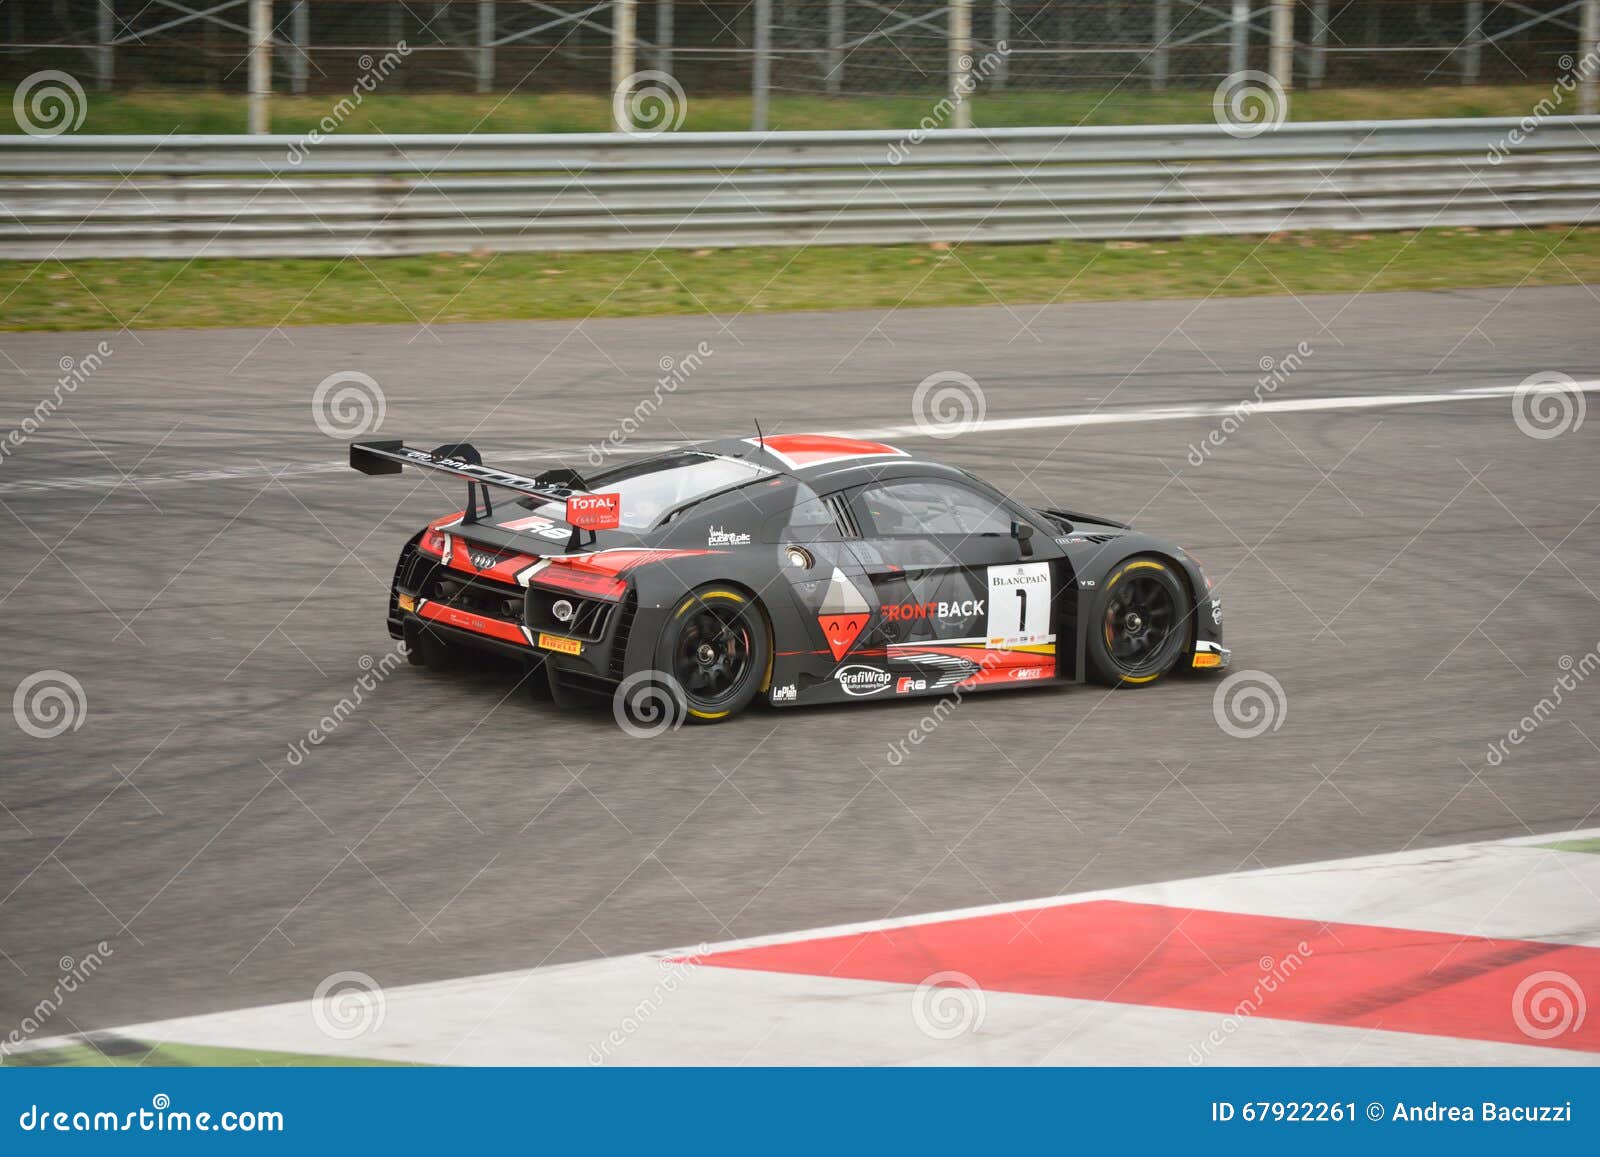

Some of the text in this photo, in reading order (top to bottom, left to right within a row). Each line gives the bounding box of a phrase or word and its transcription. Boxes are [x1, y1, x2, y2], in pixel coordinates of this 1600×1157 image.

[570, 497, 615, 510] TOTAL
[993, 574, 1048, 587] BLANCPAIN
[1016, 589, 1027, 632] 1
[840, 671, 892, 684] GrafiWrap
